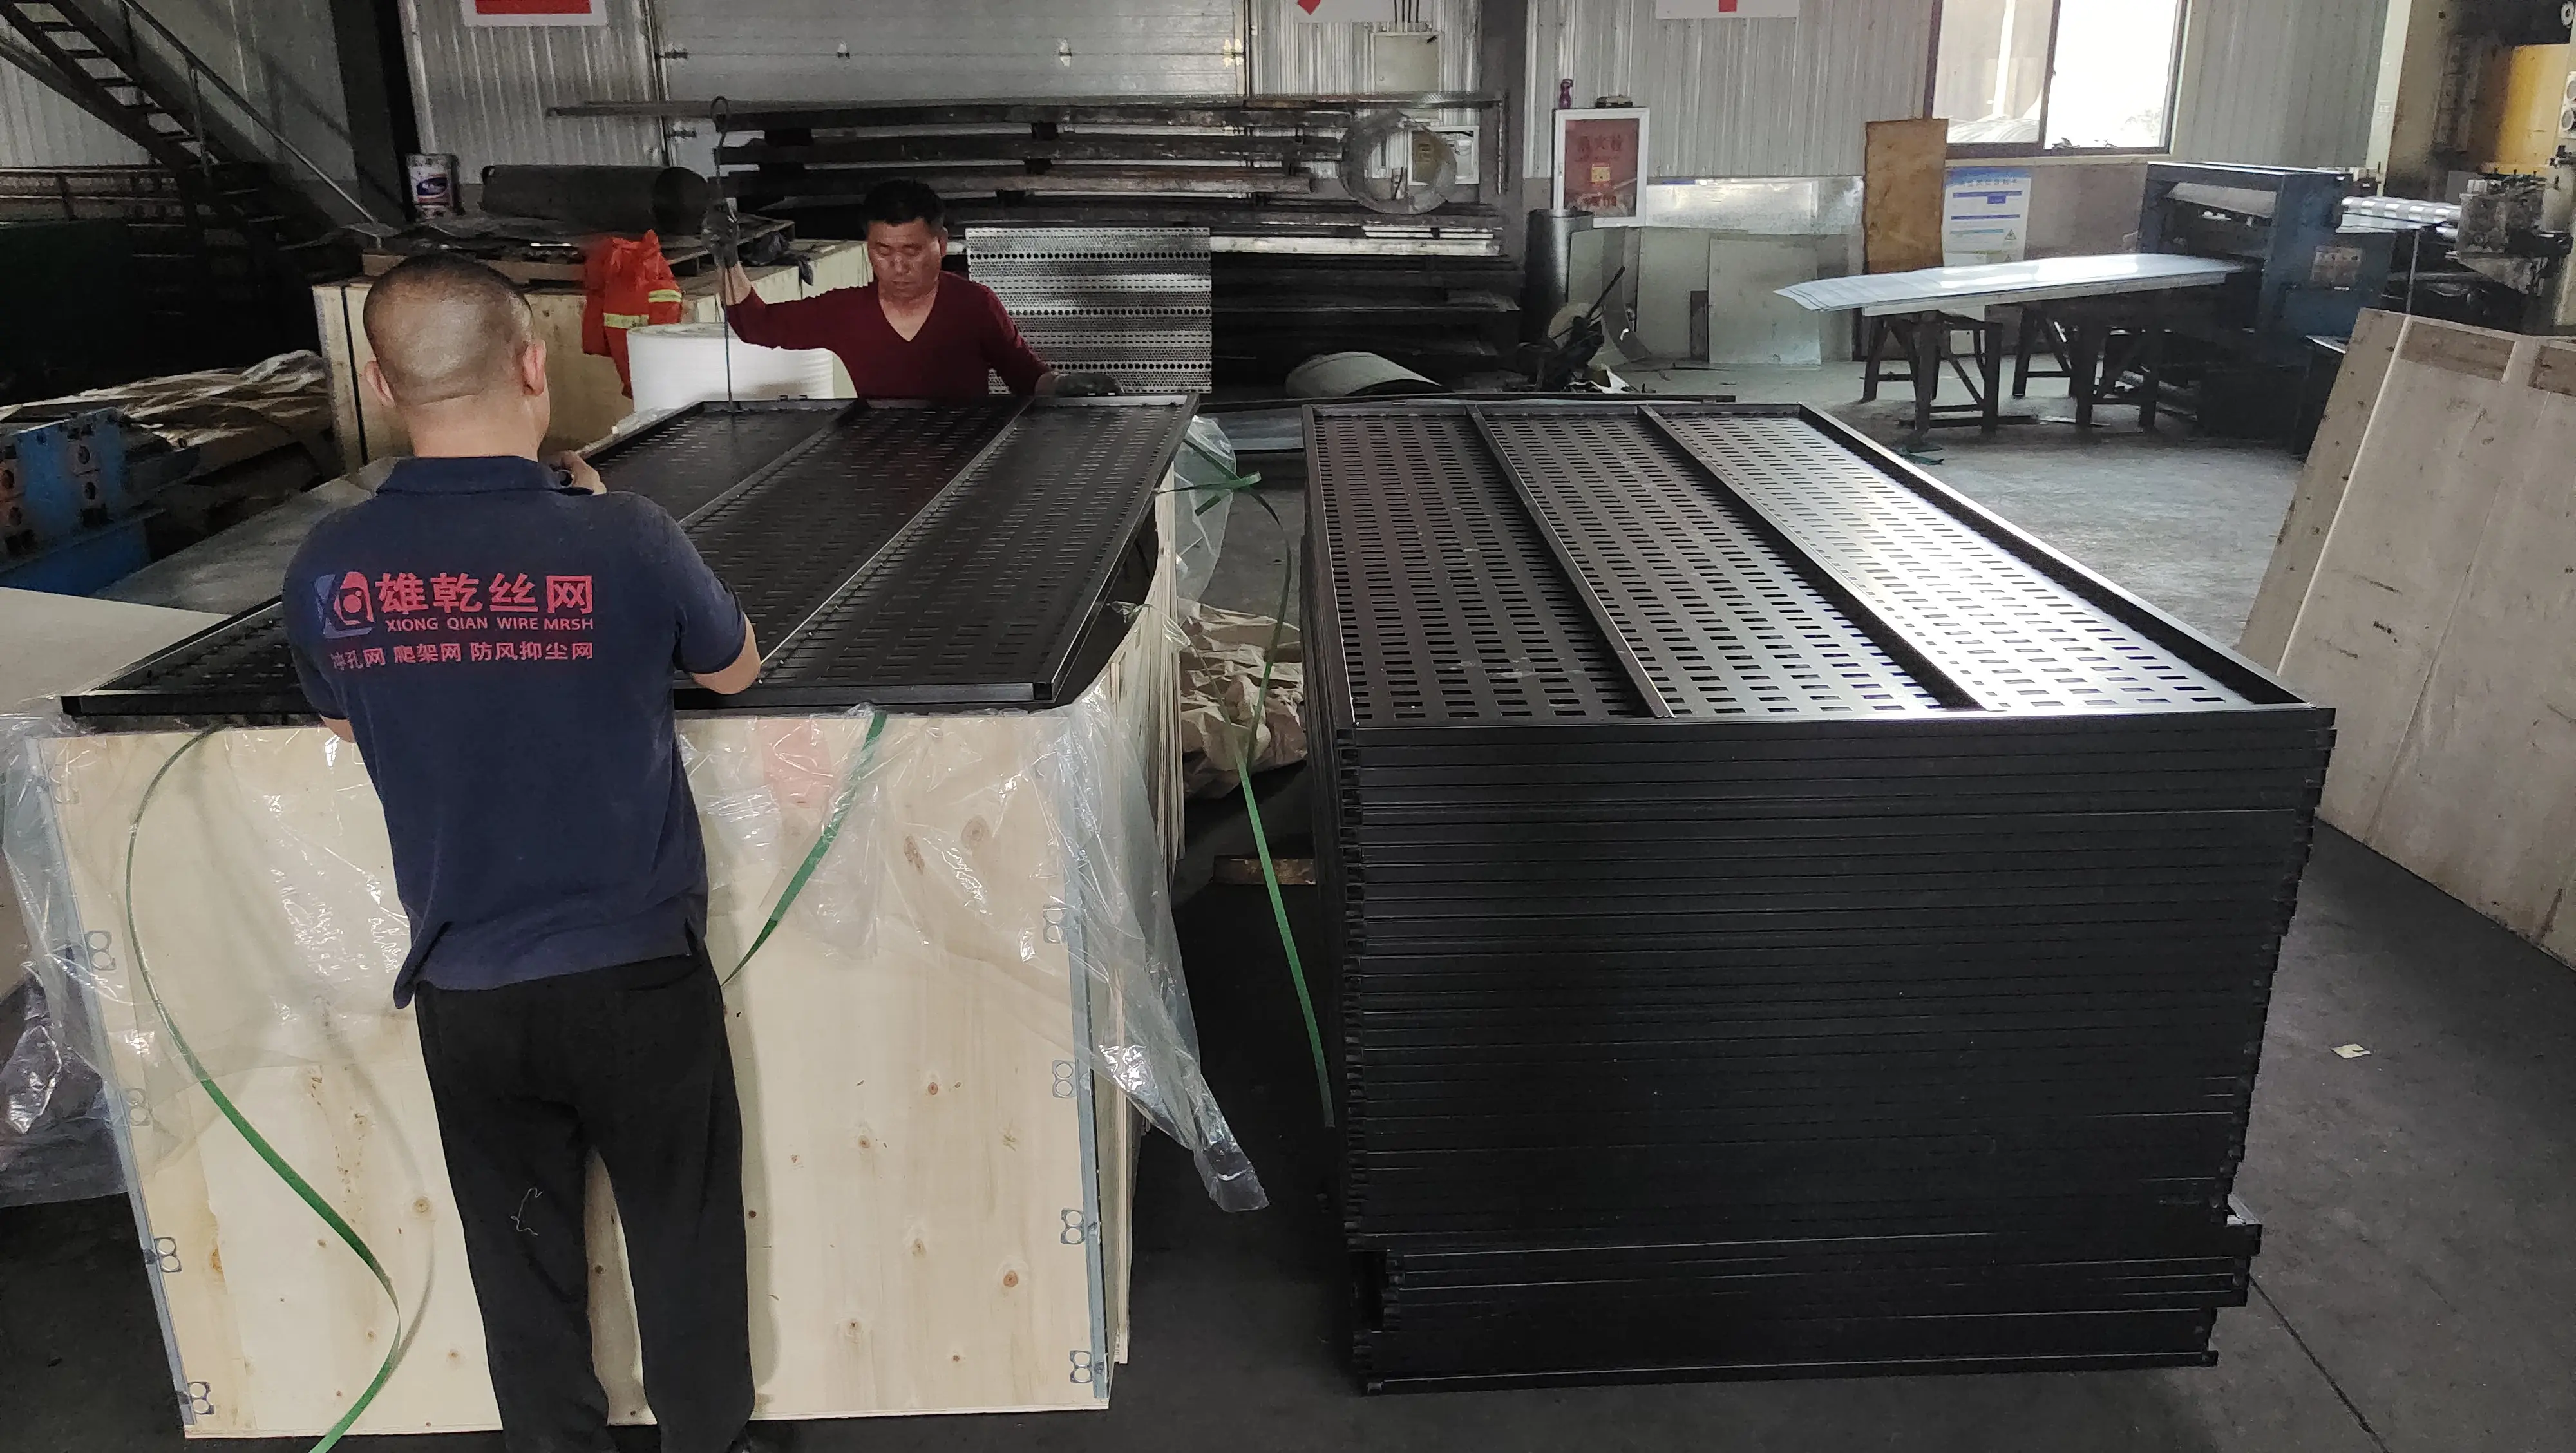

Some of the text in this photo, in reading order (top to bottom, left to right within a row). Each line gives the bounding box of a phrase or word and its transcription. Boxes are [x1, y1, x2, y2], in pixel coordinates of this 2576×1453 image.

[375, 572, 593, 614] 雄乾丝网
[386, 617, 594, 632] XIONG QIAN WIRE MRSH
[394, 643, 462, 664] 爬架网
[470, 641, 593, 661] 防风抑尘网
